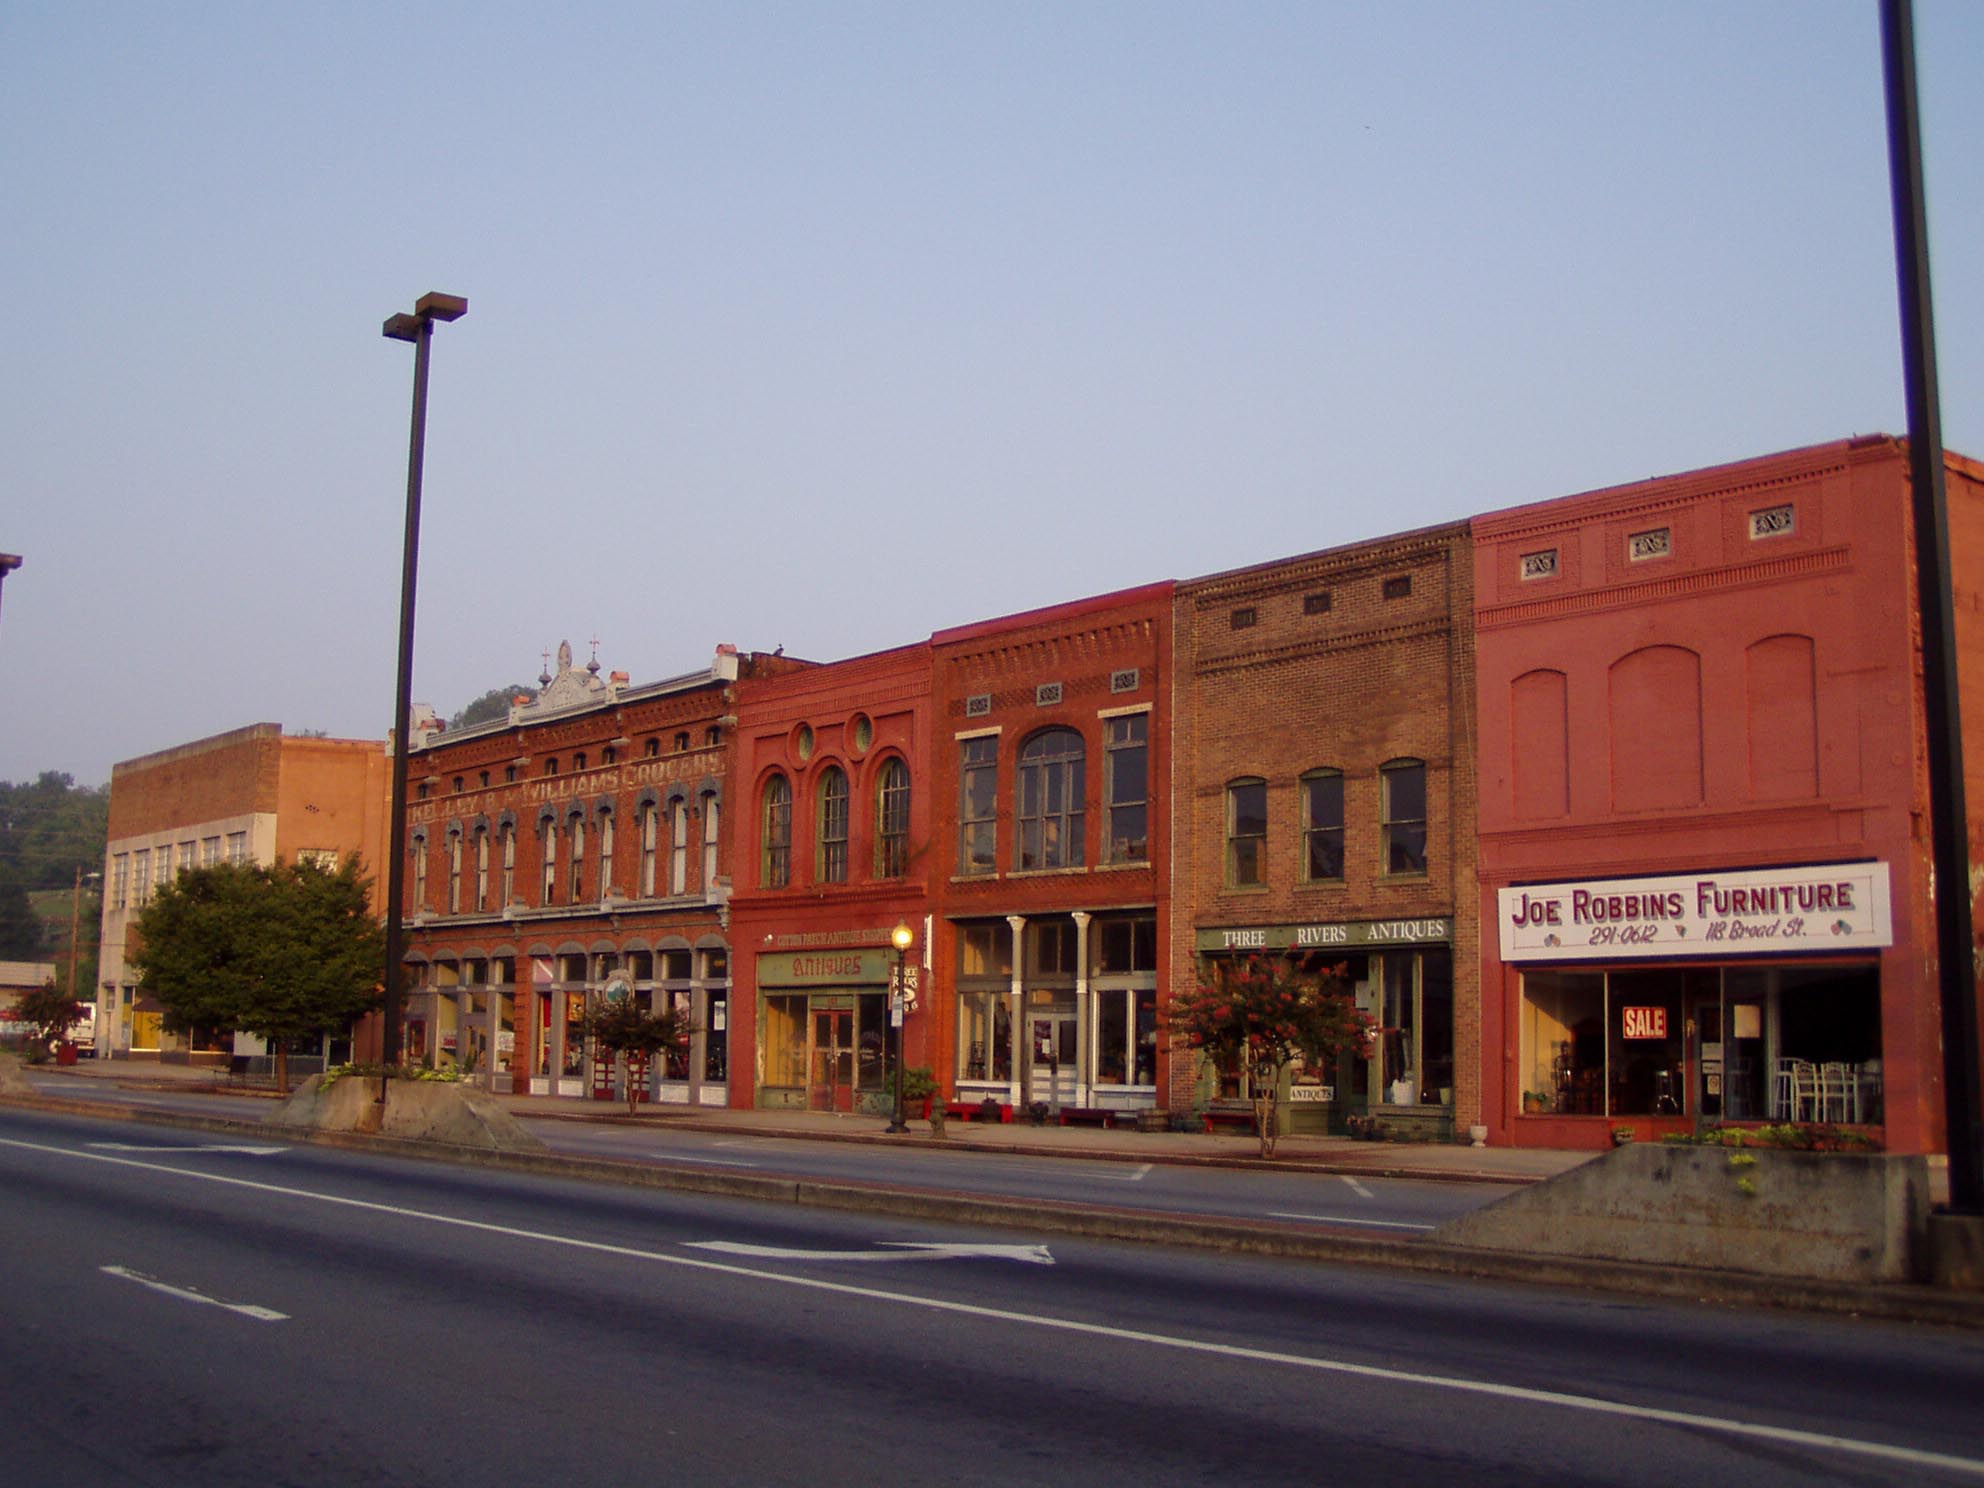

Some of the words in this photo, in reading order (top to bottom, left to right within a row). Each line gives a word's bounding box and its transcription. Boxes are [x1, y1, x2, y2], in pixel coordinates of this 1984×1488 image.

[1512, 892, 1562, 929] JOE
[1572, 889, 1685, 925] ROBBINS
[1697, 880, 1856, 919] FURNITURE
[1223, 931, 1265, 946] THREE
[1298, 926, 1347, 944] RIVERS
[1368, 920, 1444, 941] ANTIQUES
[1729, 918, 1780, 941] Broad
[1782, 917, 1807, 937] St.
[893, 966, 918, 977] TREE
[1625, 1009, 1664, 1037] SALE
[1292, 1089, 1332, 1100] ANTIQUES
